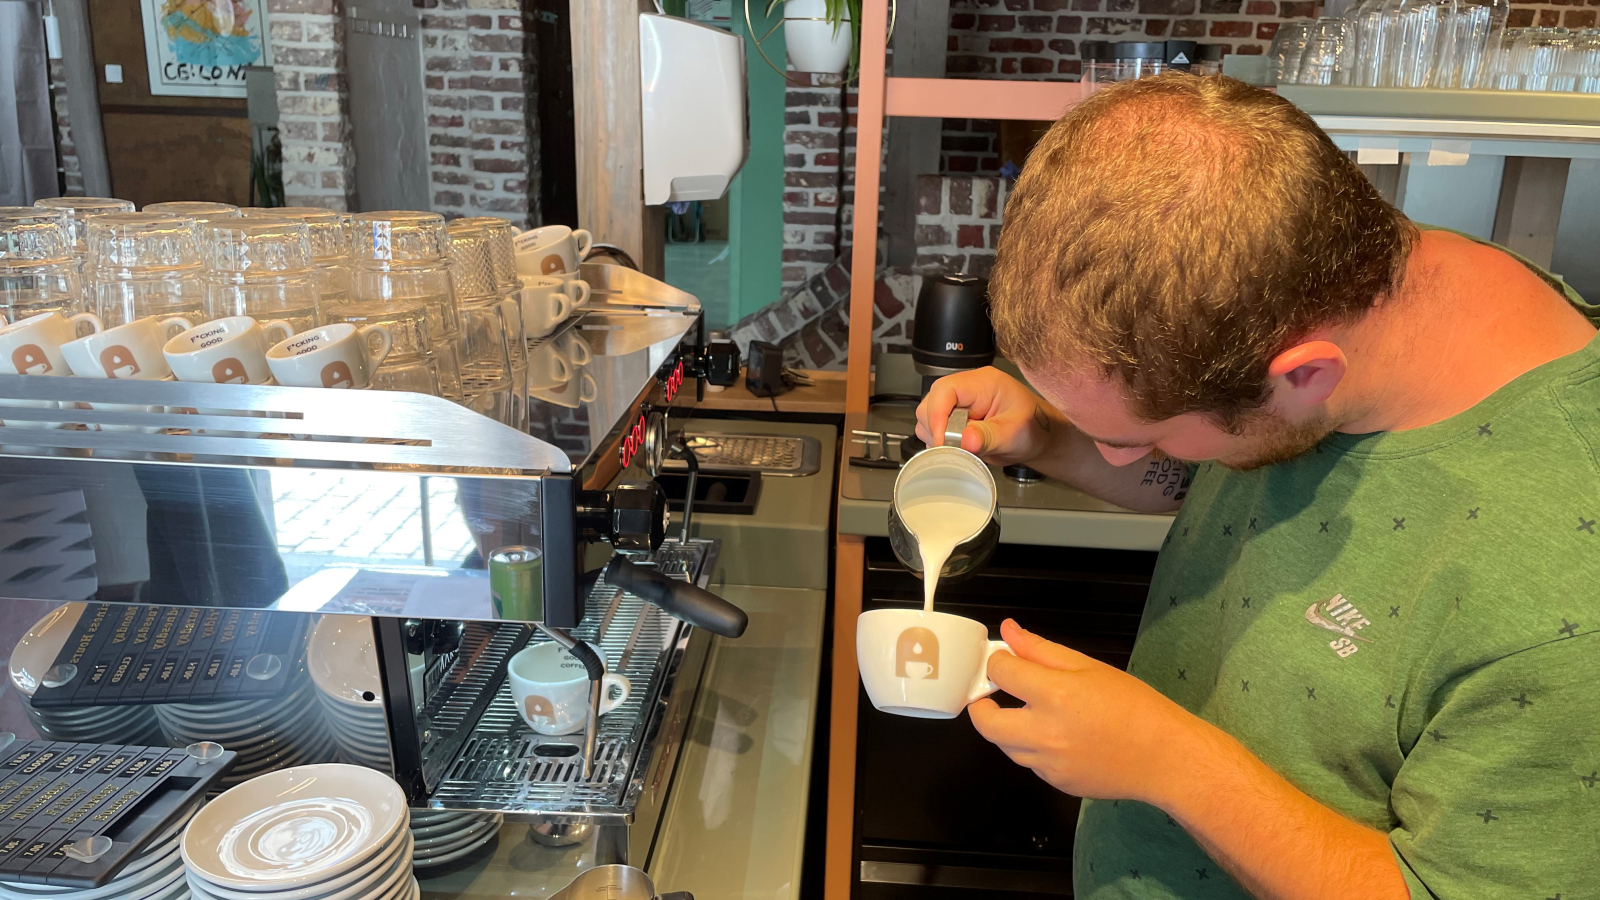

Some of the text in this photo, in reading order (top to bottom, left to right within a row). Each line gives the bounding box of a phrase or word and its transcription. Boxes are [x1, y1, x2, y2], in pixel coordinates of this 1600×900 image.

[200, 336, 223, 348] GOOD
[1325, 593, 1371, 637] NIKE
[1329, 637, 1359, 658] SB
